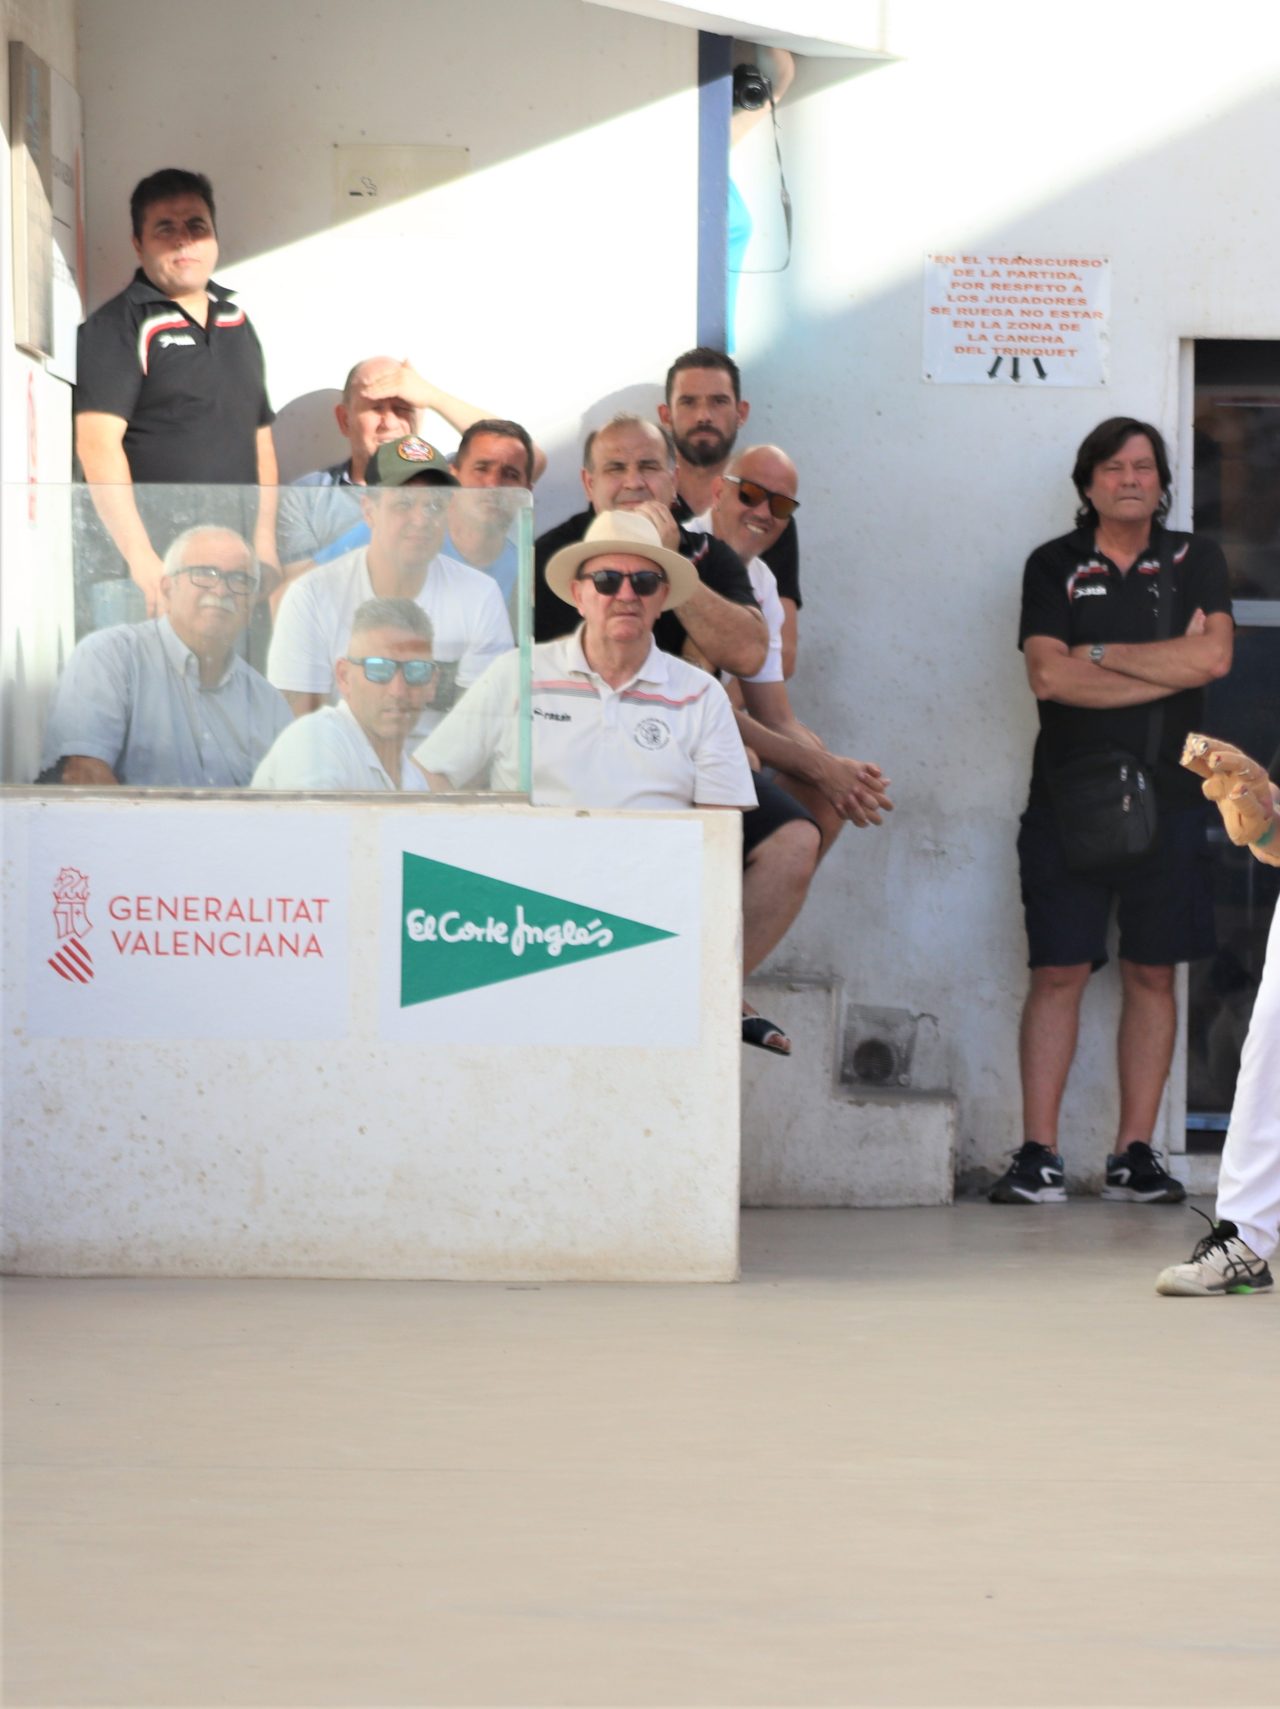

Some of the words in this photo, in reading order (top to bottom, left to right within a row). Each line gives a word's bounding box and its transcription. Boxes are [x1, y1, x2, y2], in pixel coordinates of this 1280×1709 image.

[934, 255, 956, 264] EN
[962, 256, 981, 265] EL
[987, 256, 1103, 268] TRANSCURSO
[953, 269, 976, 277] DE
[980, 269, 1001, 278] LA
[951, 282, 985, 291] POR
[991, 283, 1067, 293] RESPETO
[1072, 285, 1084, 293] A
[946, 294, 979, 303] LOS
[985, 295, 1088, 306] JUGADORES
[930, 307, 951, 316] SE
[956, 307, 1015, 317] RUEGA
[1019, 309, 1044, 318] NO
[1050, 310, 1104, 319] ESTAR
[952, 320, 975, 329] EN
[980, 321, 1002, 330] LA
[1007, 322, 1054, 331] ZONA
[1059, 323, 1081, 332] DE
[967, 334, 988, 342] LA
[994, 334, 1065, 344] CANCHA
[954, 346, 987, 355] DEL
[992, 347, 1079, 357] TRINQUET
[108, 896, 330, 923] GENERALITAT
[406, 908, 437, 942] El
[438, 911, 509, 944] Corte
[511, 904, 614, 957] Inglés
[111, 930, 325, 958] VALENCIANA
